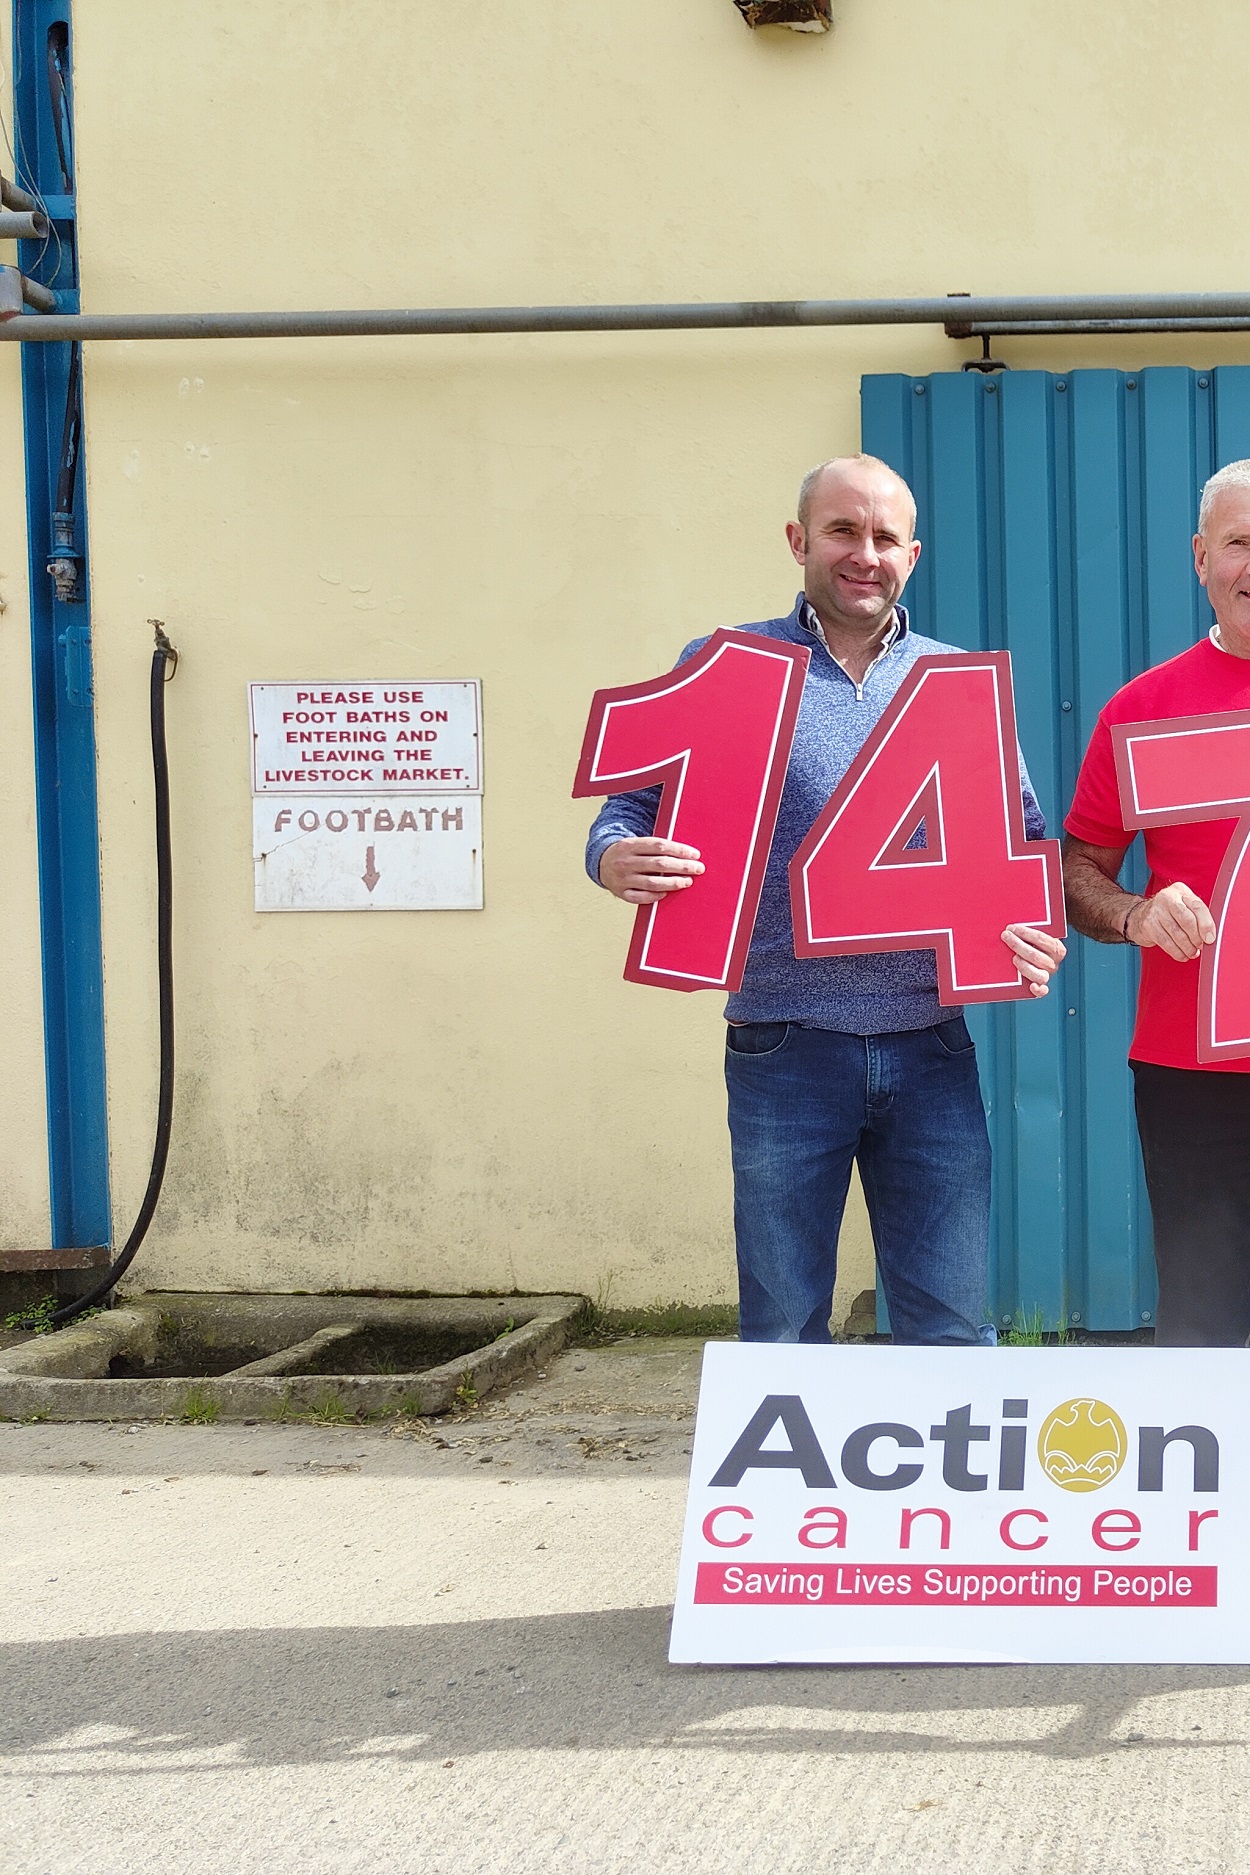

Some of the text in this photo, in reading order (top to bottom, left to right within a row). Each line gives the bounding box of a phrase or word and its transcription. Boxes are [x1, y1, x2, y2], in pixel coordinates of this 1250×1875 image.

[296, 691, 424, 705] PLEASE USE
[282, 710, 449, 725] FOOT BATHS ON
[285, 730, 438, 744] ENTERING AND
[301, 748, 433, 763] LEAVING THE
[264, 768, 470, 783] LIVESTOCK MARKET.
[274, 806, 463, 833] FOOTBATH
[706, 1393, 1220, 1494] Action
[701, 1505, 1219, 1552] cancer
[722, 1566, 1192, 1603] Saving Lives Supporting People
